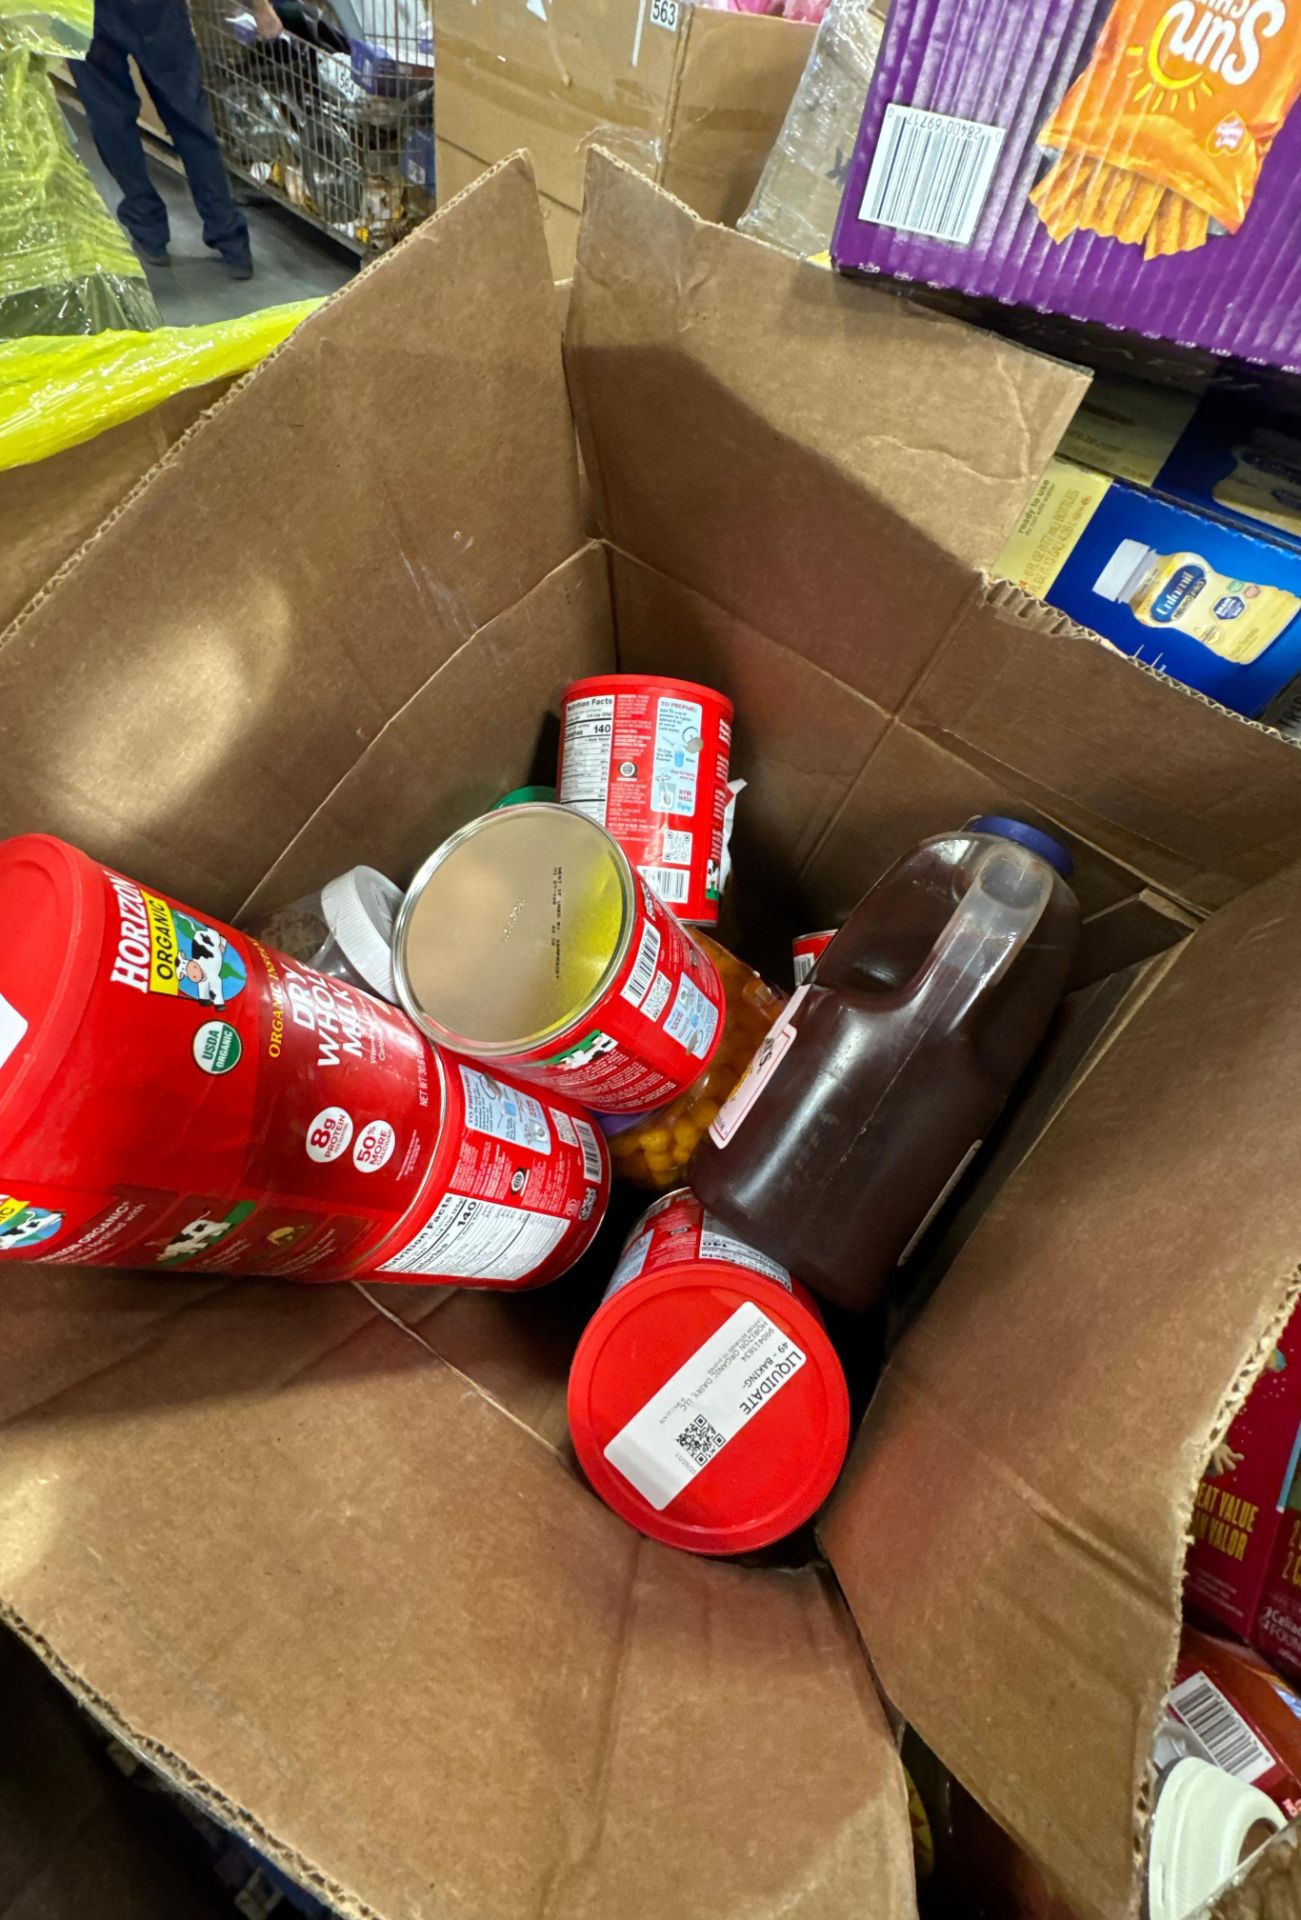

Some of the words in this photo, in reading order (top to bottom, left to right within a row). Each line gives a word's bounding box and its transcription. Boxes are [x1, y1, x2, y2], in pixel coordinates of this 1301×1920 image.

[653, 0, 676, 26] 563
[907, 113, 942, 130] 69717
[946, 121, 982, 139] 28400
[1016, 508, 1036, 534] ready
[1030, 496, 1040, 508] to
[1036, 478, 1050, 496] use
[1052, 486, 1079, 523] BOTTLES
[591, 697, 612, 705] Facts
[593, 724, 610, 733] 140
[103, 870, 150, 993] HORIZON
[149, 900, 174, 980] ORGANIC
[280, 961, 315, 1031] DRY
[269, 982, 283, 1058] ORGANIC
[328, 983, 363, 1057] MILK
[202, 1029, 220, 1060] USDA
[216, 1029, 233, 1069] ORGANIC
[418, 1076, 429, 1092] WT
[419, 1094, 429, 1107] NET
[311, 1117, 337, 1149] 8g
[325, 1114, 346, 1158] PROTEIN
[356, 1125, 377, 1163] 50%
[369, 1130, 389, 1166] MORE
[456, 1200, 477, 1228] 140
[378, 1229, 431, 1271] Nutrition
[426, 1194, 453, 1230] Facts
[738, 1320, 768, 1351] HORIZON
[775, 1340, 789, 1353] 49
[710, 1348, 740, 1379] ORGANIC
[740, 1355, 774, 1391] BAKING-
[689, 1376, 713, 1400] DAIRY,
[738, 1349, 802, 1416] LIQUIDATE
[678, 1397, 693, 1411] LLC
[1219, 1491, 1259, 1533] VALUE
[1208, 1520, 1248, 1561] VALOR
